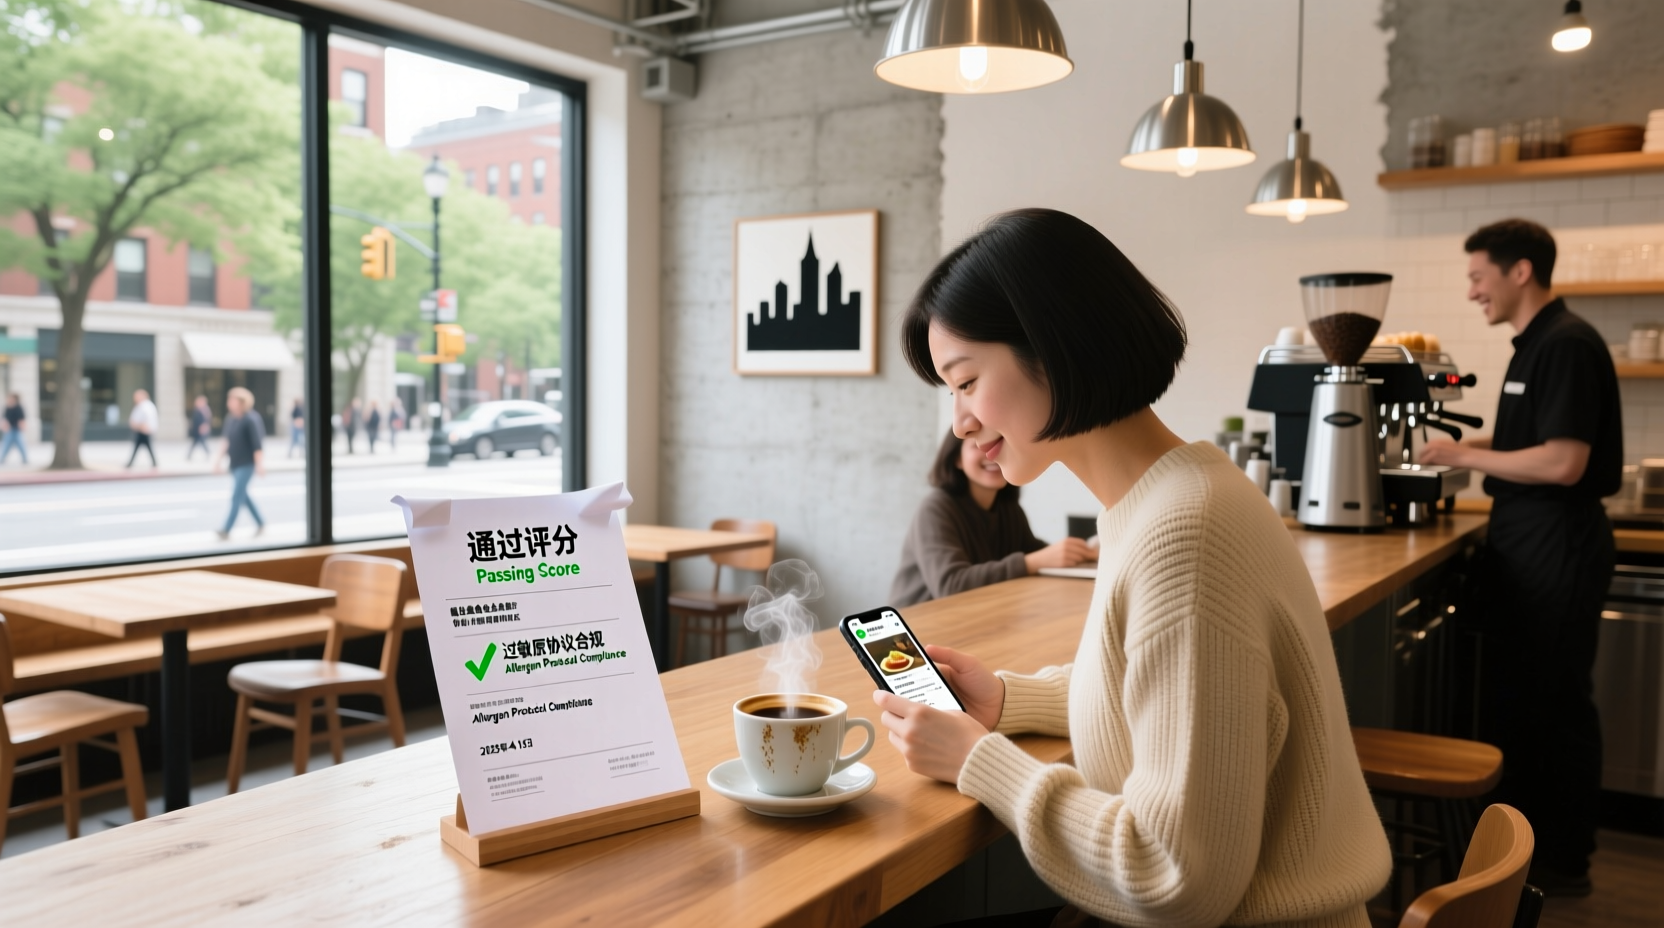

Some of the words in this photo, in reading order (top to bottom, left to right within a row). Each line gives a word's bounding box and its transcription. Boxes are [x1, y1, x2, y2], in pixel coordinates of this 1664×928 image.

[467, 524, 578, 563] 通过评分
[476, 566, 535, 584] Passing
[537, 562, 580, 578] Score
[502, 630, 605, 660] 过敏原协议合规
